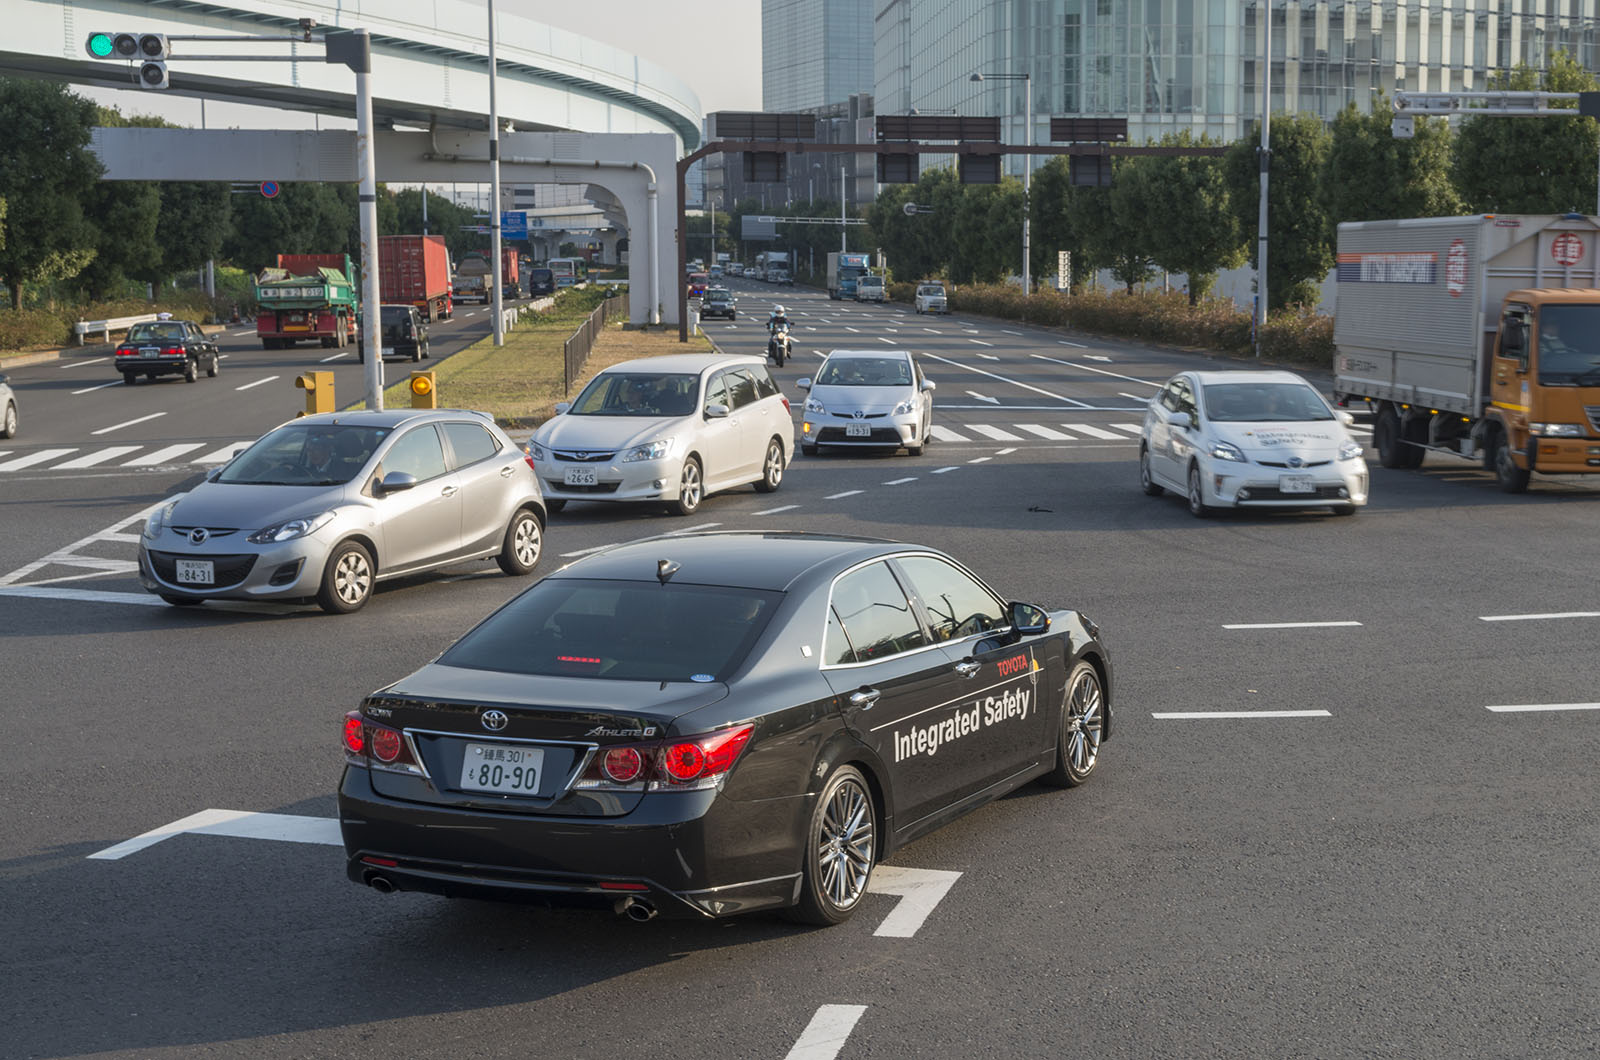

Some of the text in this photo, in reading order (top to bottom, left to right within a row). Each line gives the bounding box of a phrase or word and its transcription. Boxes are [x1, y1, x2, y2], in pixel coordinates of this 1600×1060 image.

[571, 474, 594, 483] 26-65
[184, 569, 211, 582] 84-31
[997, 653, 1029, 677] TOYOTA
[584, 725, 642, 737] ATHLETE
[894, 687, 1030, 763] Integrated Safety
[478, 763, 537, 790] 80-90
